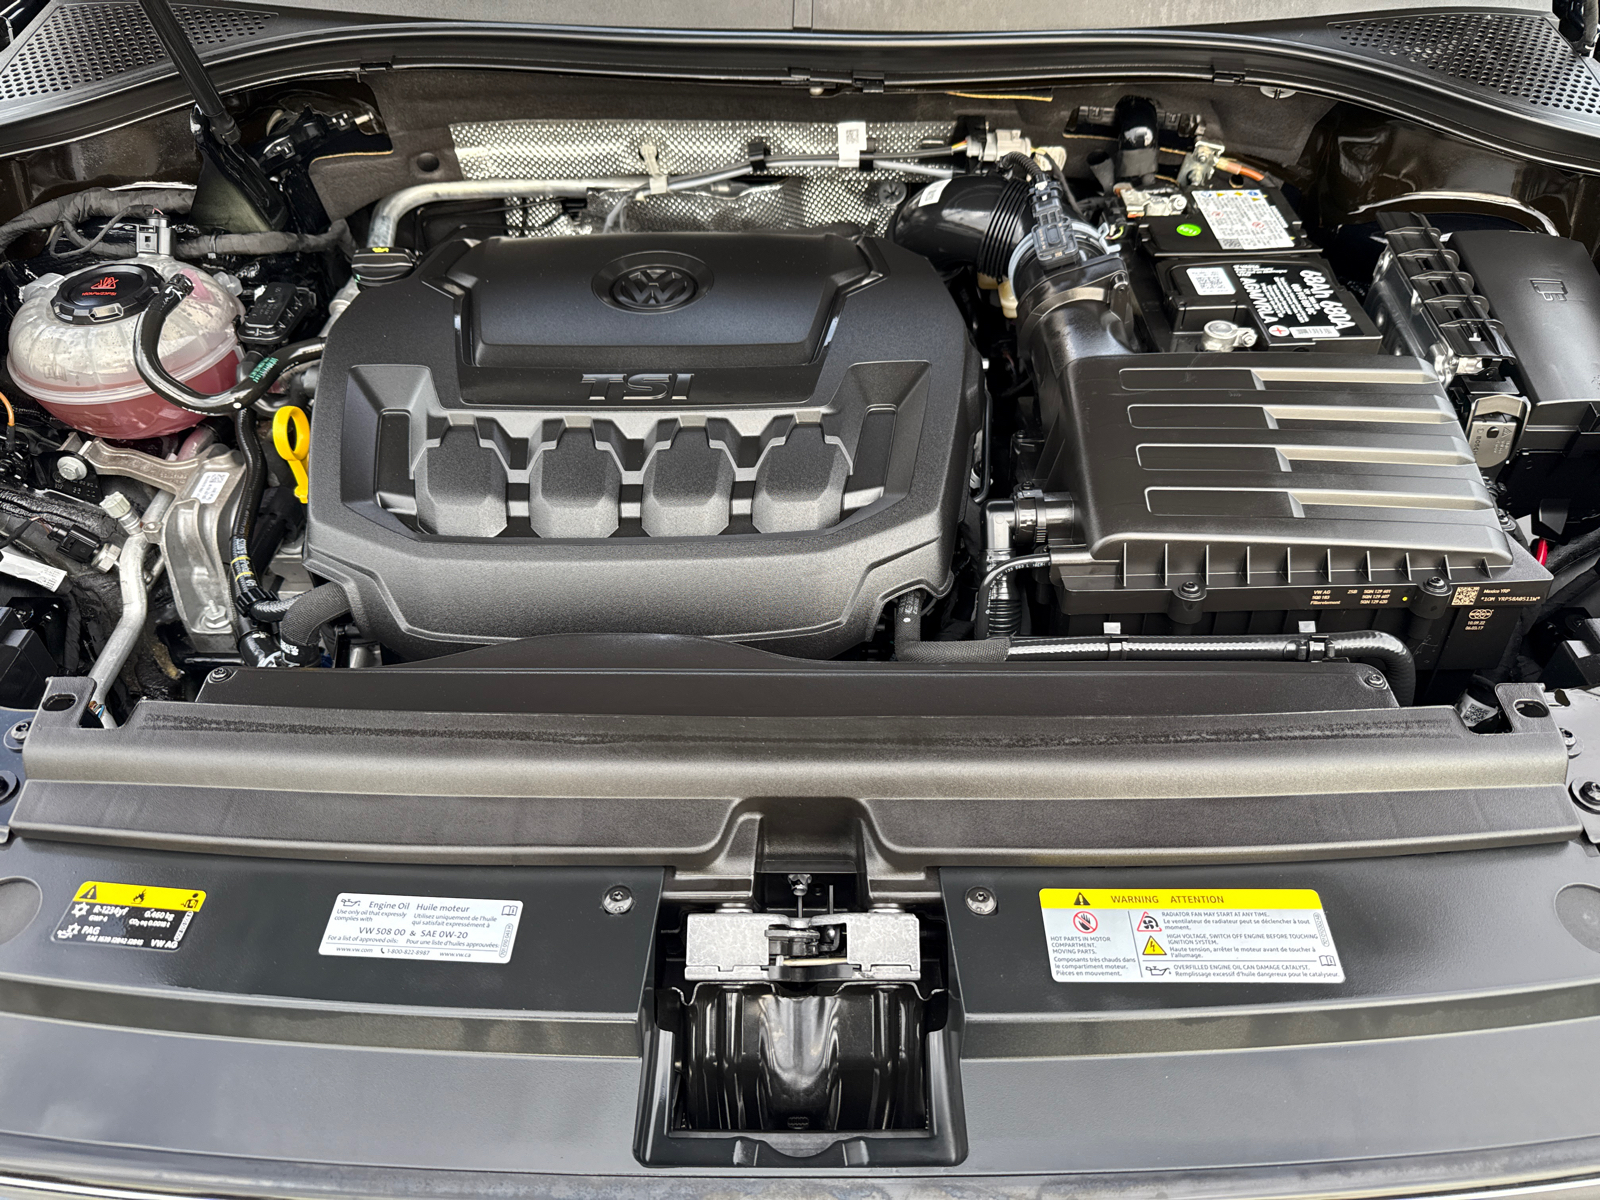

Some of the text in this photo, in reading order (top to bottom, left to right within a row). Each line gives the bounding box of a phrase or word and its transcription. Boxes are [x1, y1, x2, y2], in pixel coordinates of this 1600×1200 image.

[1240, 278, 1279, 323] AGM/VRLA
[1300, 270, 1334, 298] 68Ah
[1319, 300, 1355, 330] 680A
[581, 373, 694, 400] TSI
[1110, 895, 1224, 904] WARNING ATTENTION
[92, 905, 129, 917] R-1234yf
[368, 901, 411, 911] Engine Oil
[416, 903, 470, 913] Huile moteur
[380, 911, 407, 919] expressly
[435, 914, 471, 922] uniquement
[81, 925, 100, 935] PAG
[393, 928, 406, 936] 00
[420, 930, 437, 938] SAE
[439, 930, 468, 939] 0W-20
[150, 939, 178, 949] VW AG
